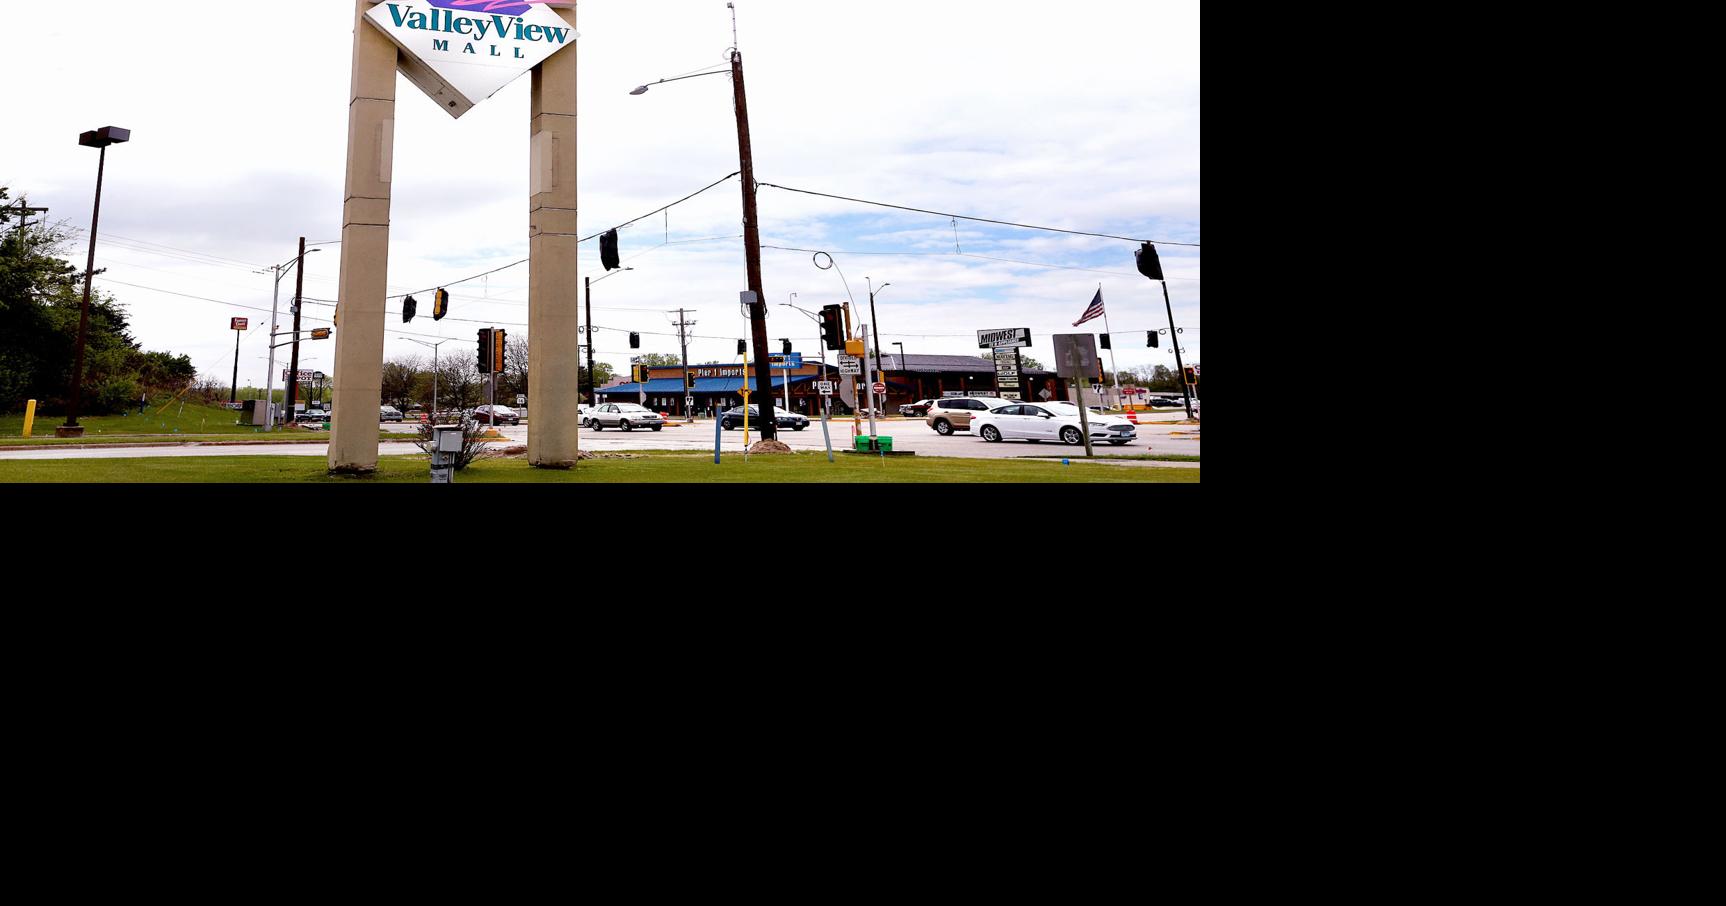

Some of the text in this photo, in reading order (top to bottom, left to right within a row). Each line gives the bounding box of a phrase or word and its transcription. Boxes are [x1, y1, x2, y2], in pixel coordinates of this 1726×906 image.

[386, 3, 570, 44] ValleyView
[433, 39, 524, 59] MALL
[980, 328, 1016, 344] MIDWEST
[697, 368, 711, 376] Pier
[714, 368, 717, 376] 1
